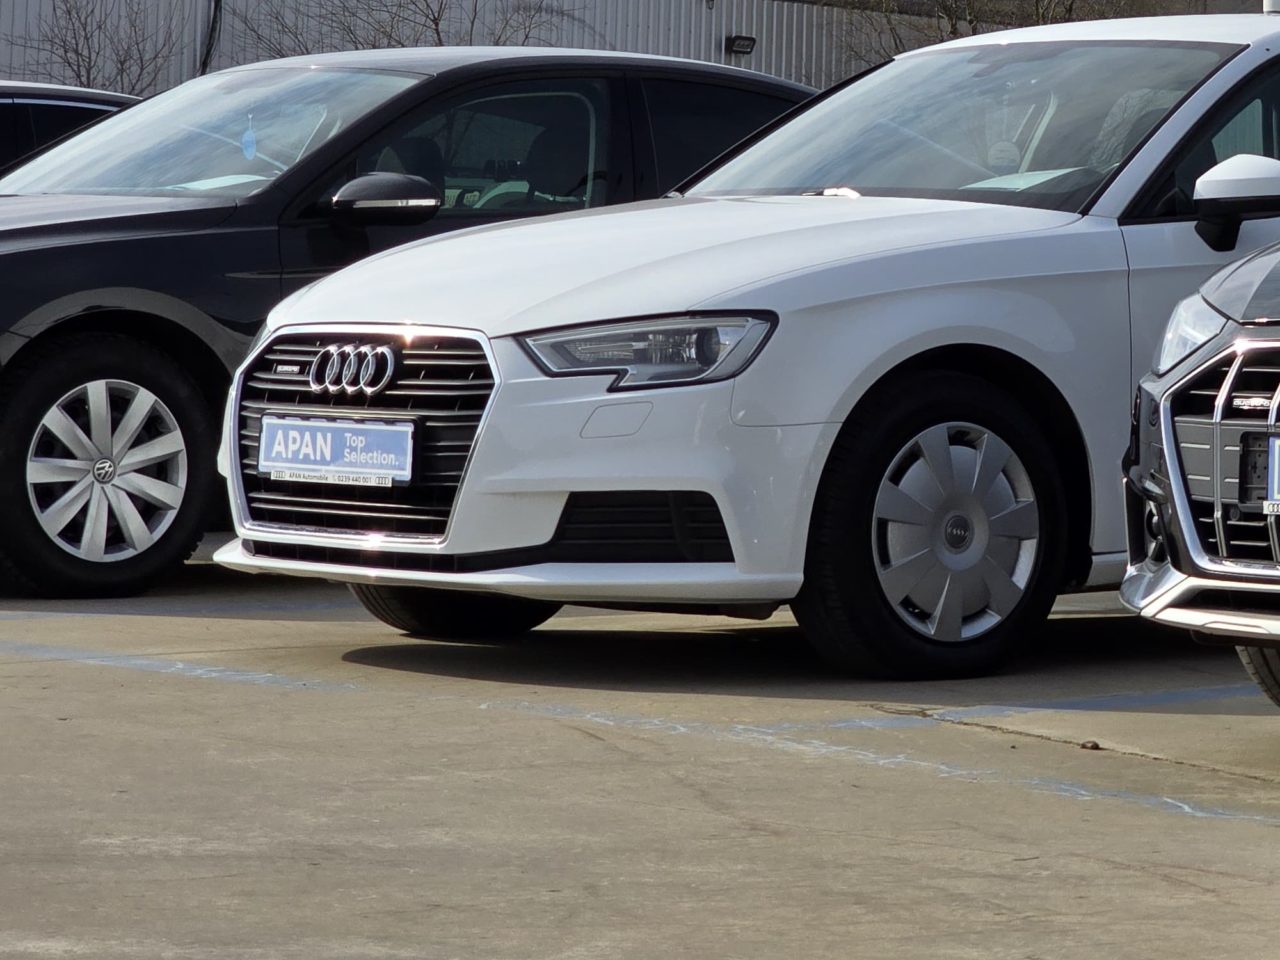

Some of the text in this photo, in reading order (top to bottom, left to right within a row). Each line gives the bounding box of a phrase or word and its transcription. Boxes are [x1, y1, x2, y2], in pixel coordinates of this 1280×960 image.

[271, 429, 332, 461] APAN
[344, 433, 365, 448] Top
[344, 448, 399, 466] Selection.
